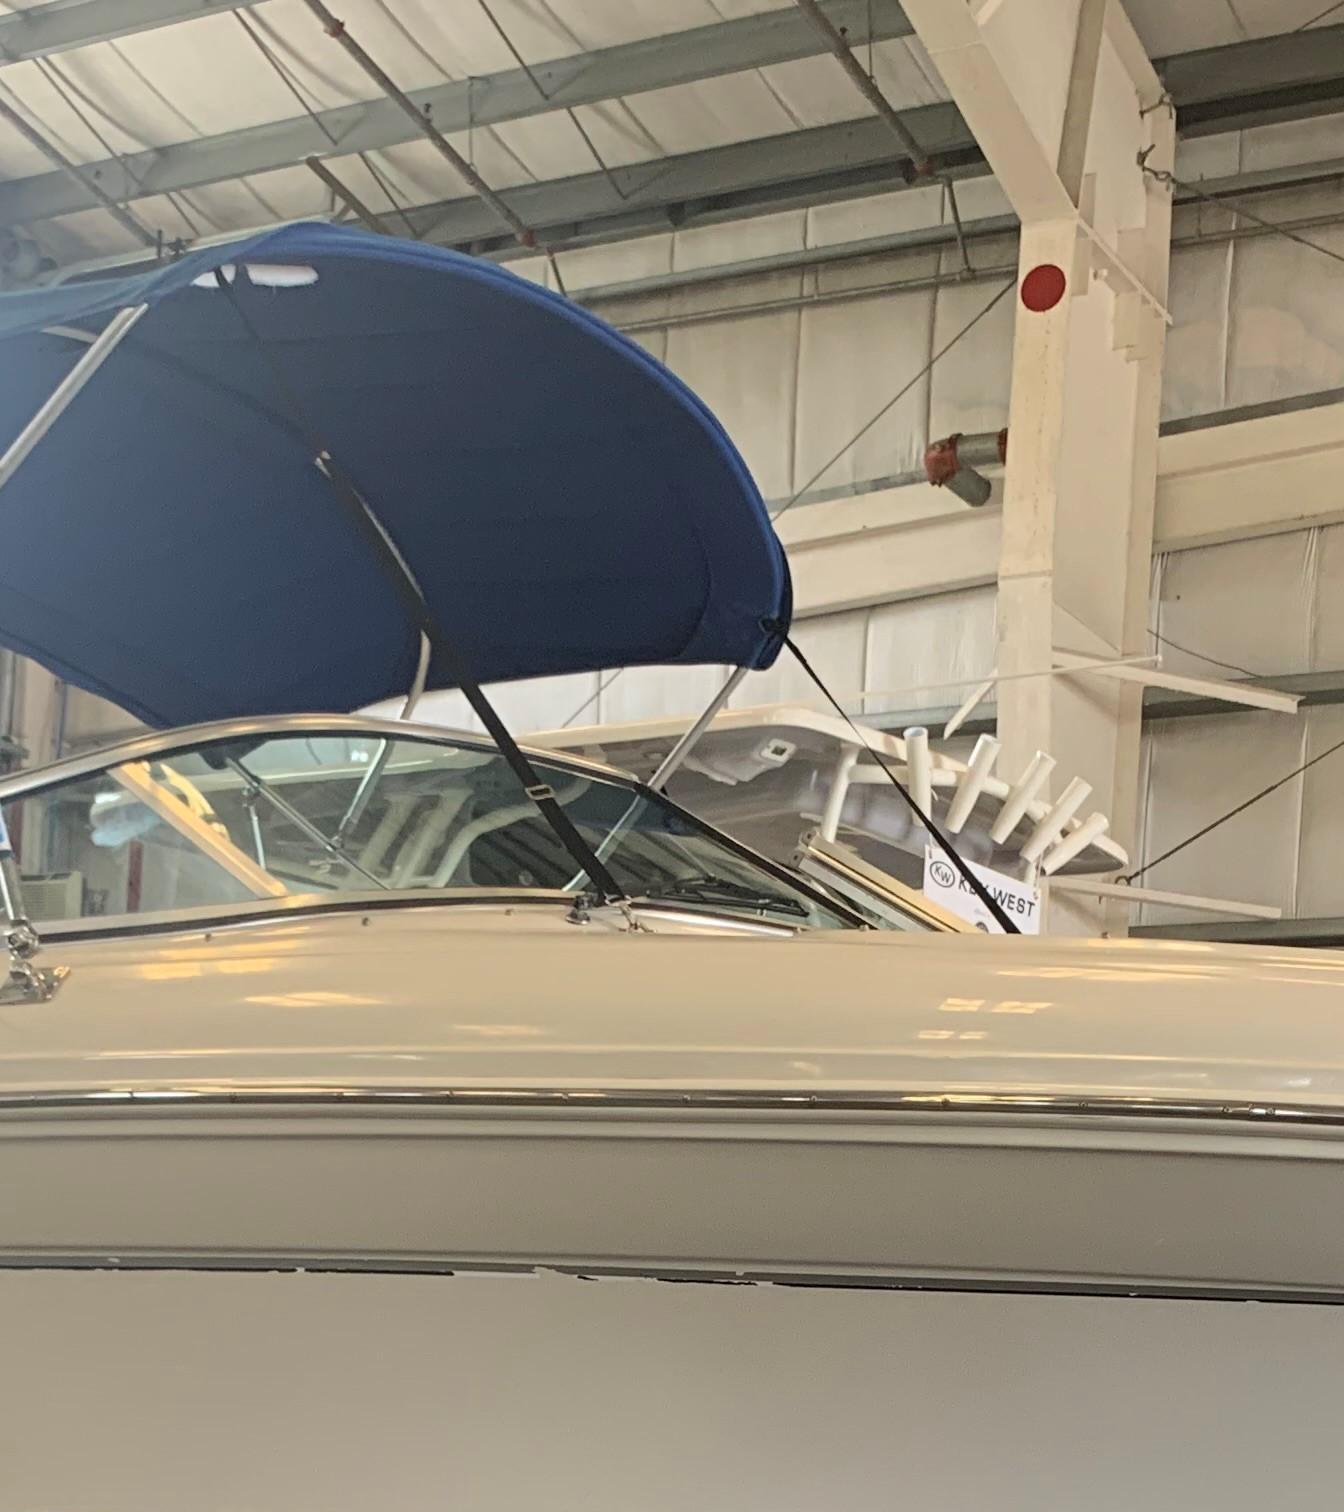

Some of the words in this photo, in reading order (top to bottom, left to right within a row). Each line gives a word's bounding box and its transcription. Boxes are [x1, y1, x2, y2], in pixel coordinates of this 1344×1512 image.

[934, 864, 952, 884] KW
[958, 873, 989, 895] KE
[993, 887, 1035, 917] WEST
